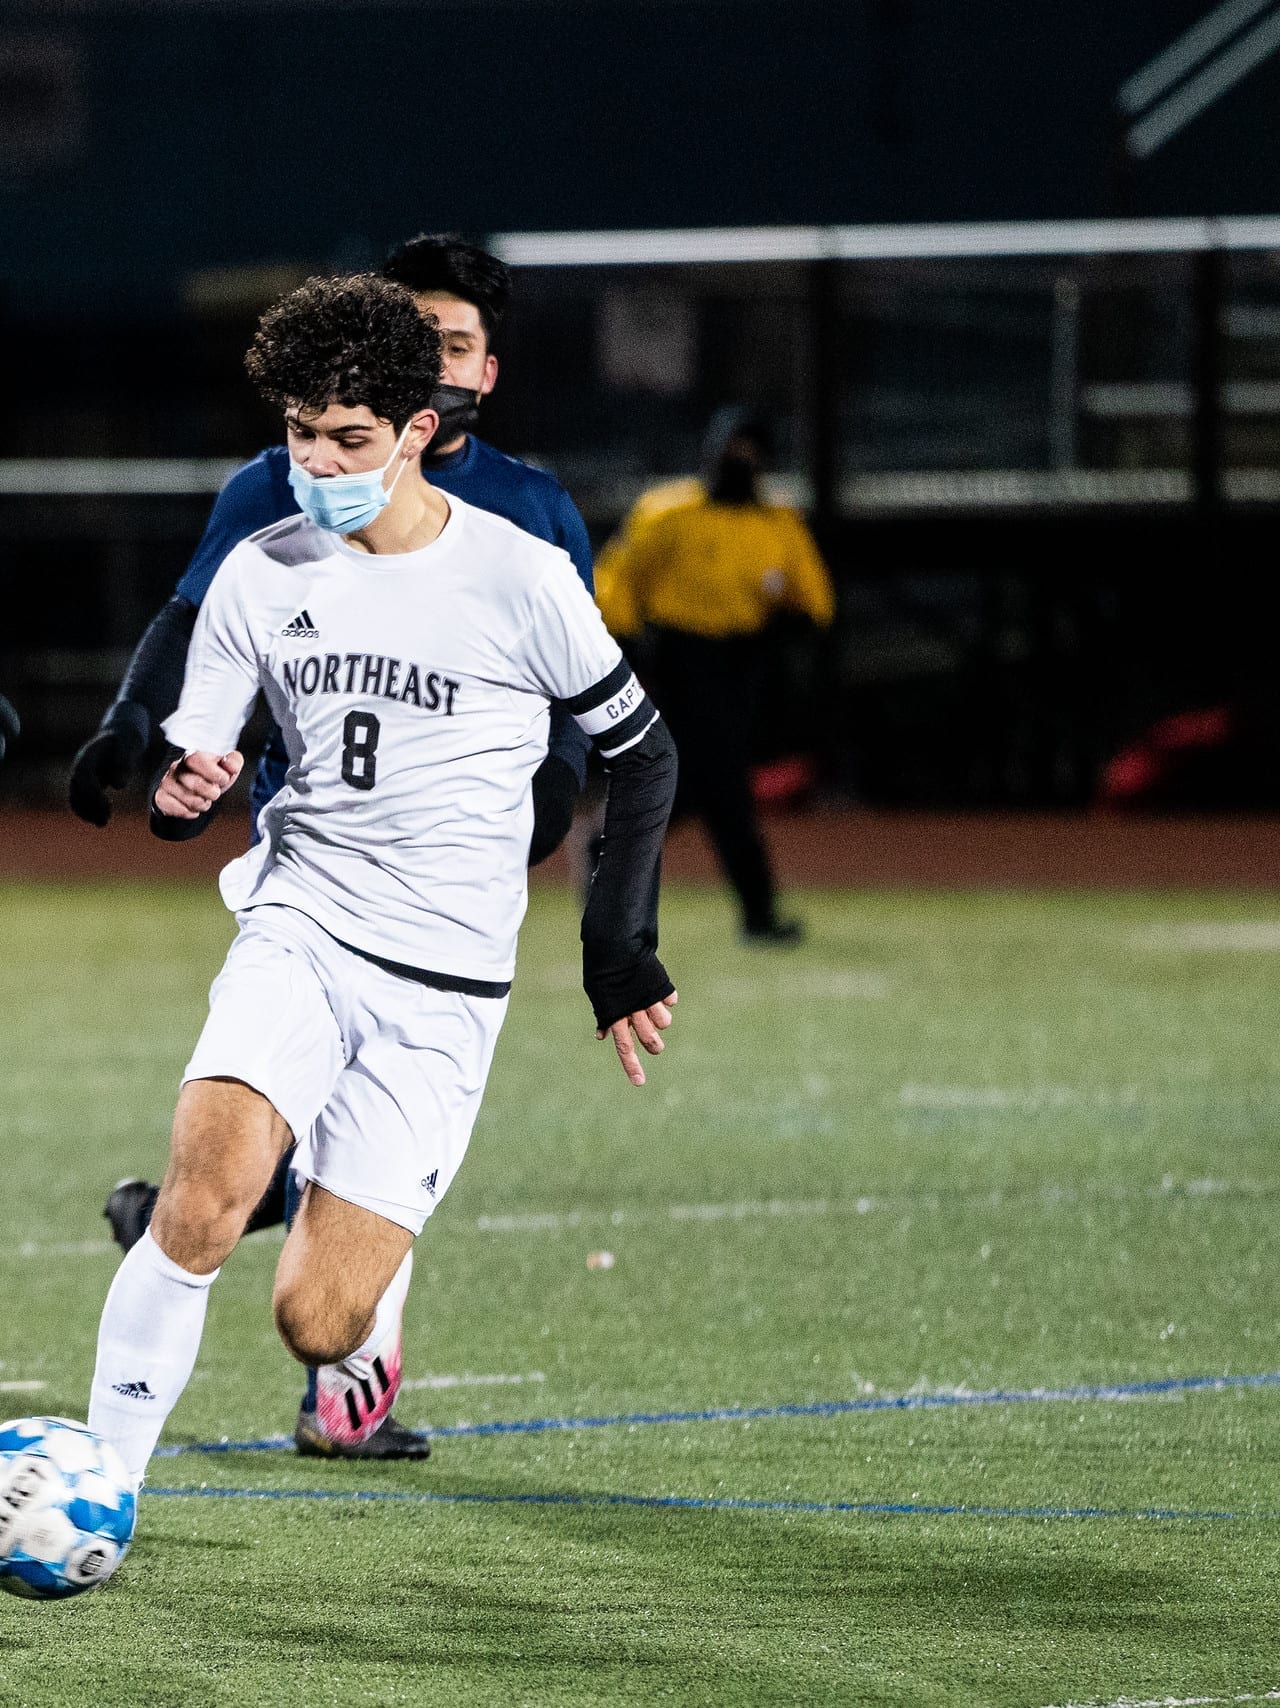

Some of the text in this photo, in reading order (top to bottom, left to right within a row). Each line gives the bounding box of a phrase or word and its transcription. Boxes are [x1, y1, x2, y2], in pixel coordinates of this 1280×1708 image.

[281, 628, 319, 639] adidas
[282, 652, 460, 716] NORTHEAST
[341, 710, 380, 791] 8
